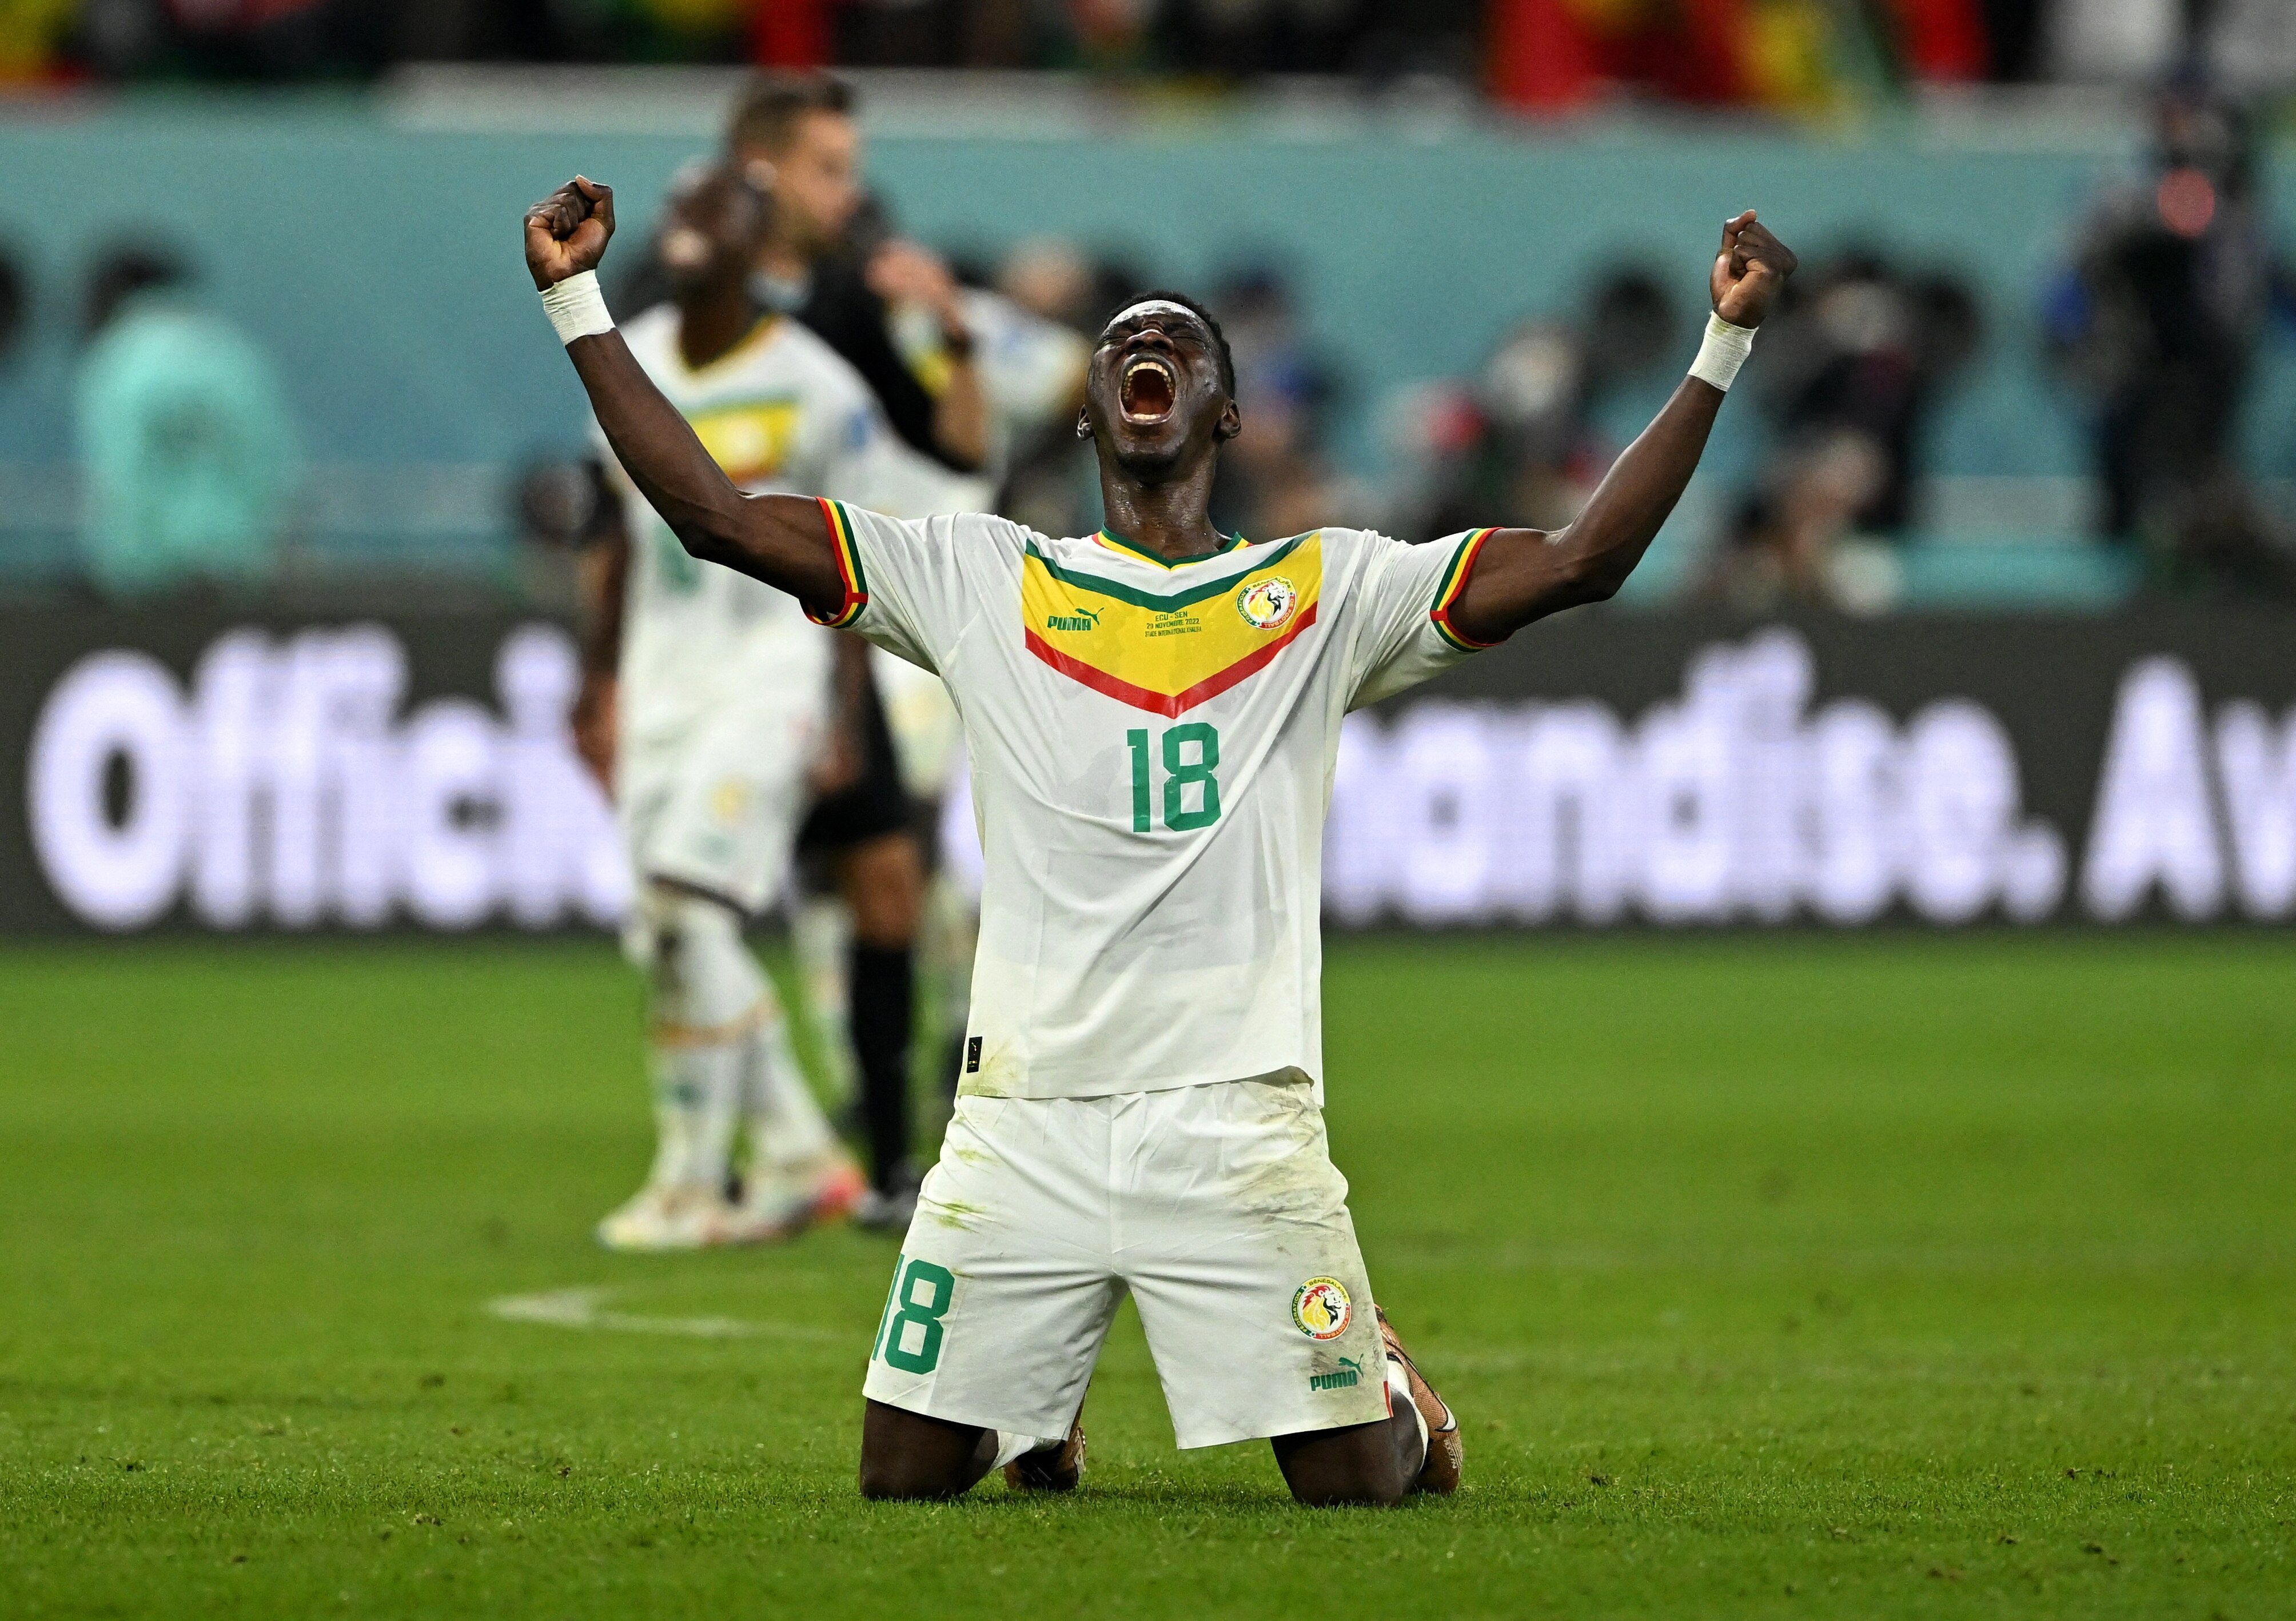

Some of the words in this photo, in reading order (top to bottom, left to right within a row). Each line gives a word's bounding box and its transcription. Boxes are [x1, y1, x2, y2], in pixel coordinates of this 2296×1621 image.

[1047, 616, 1091, 630] PUMA
[1155, 620, 1184, 629] NOVEMBRE
[1127, 722, 1222, 832] 18
[871, 1253, 955, 1375] 8
[1320, 1320, 1347, 1338] FOOTBALL
[1310, 1370, 1358, 1391] PUMA
